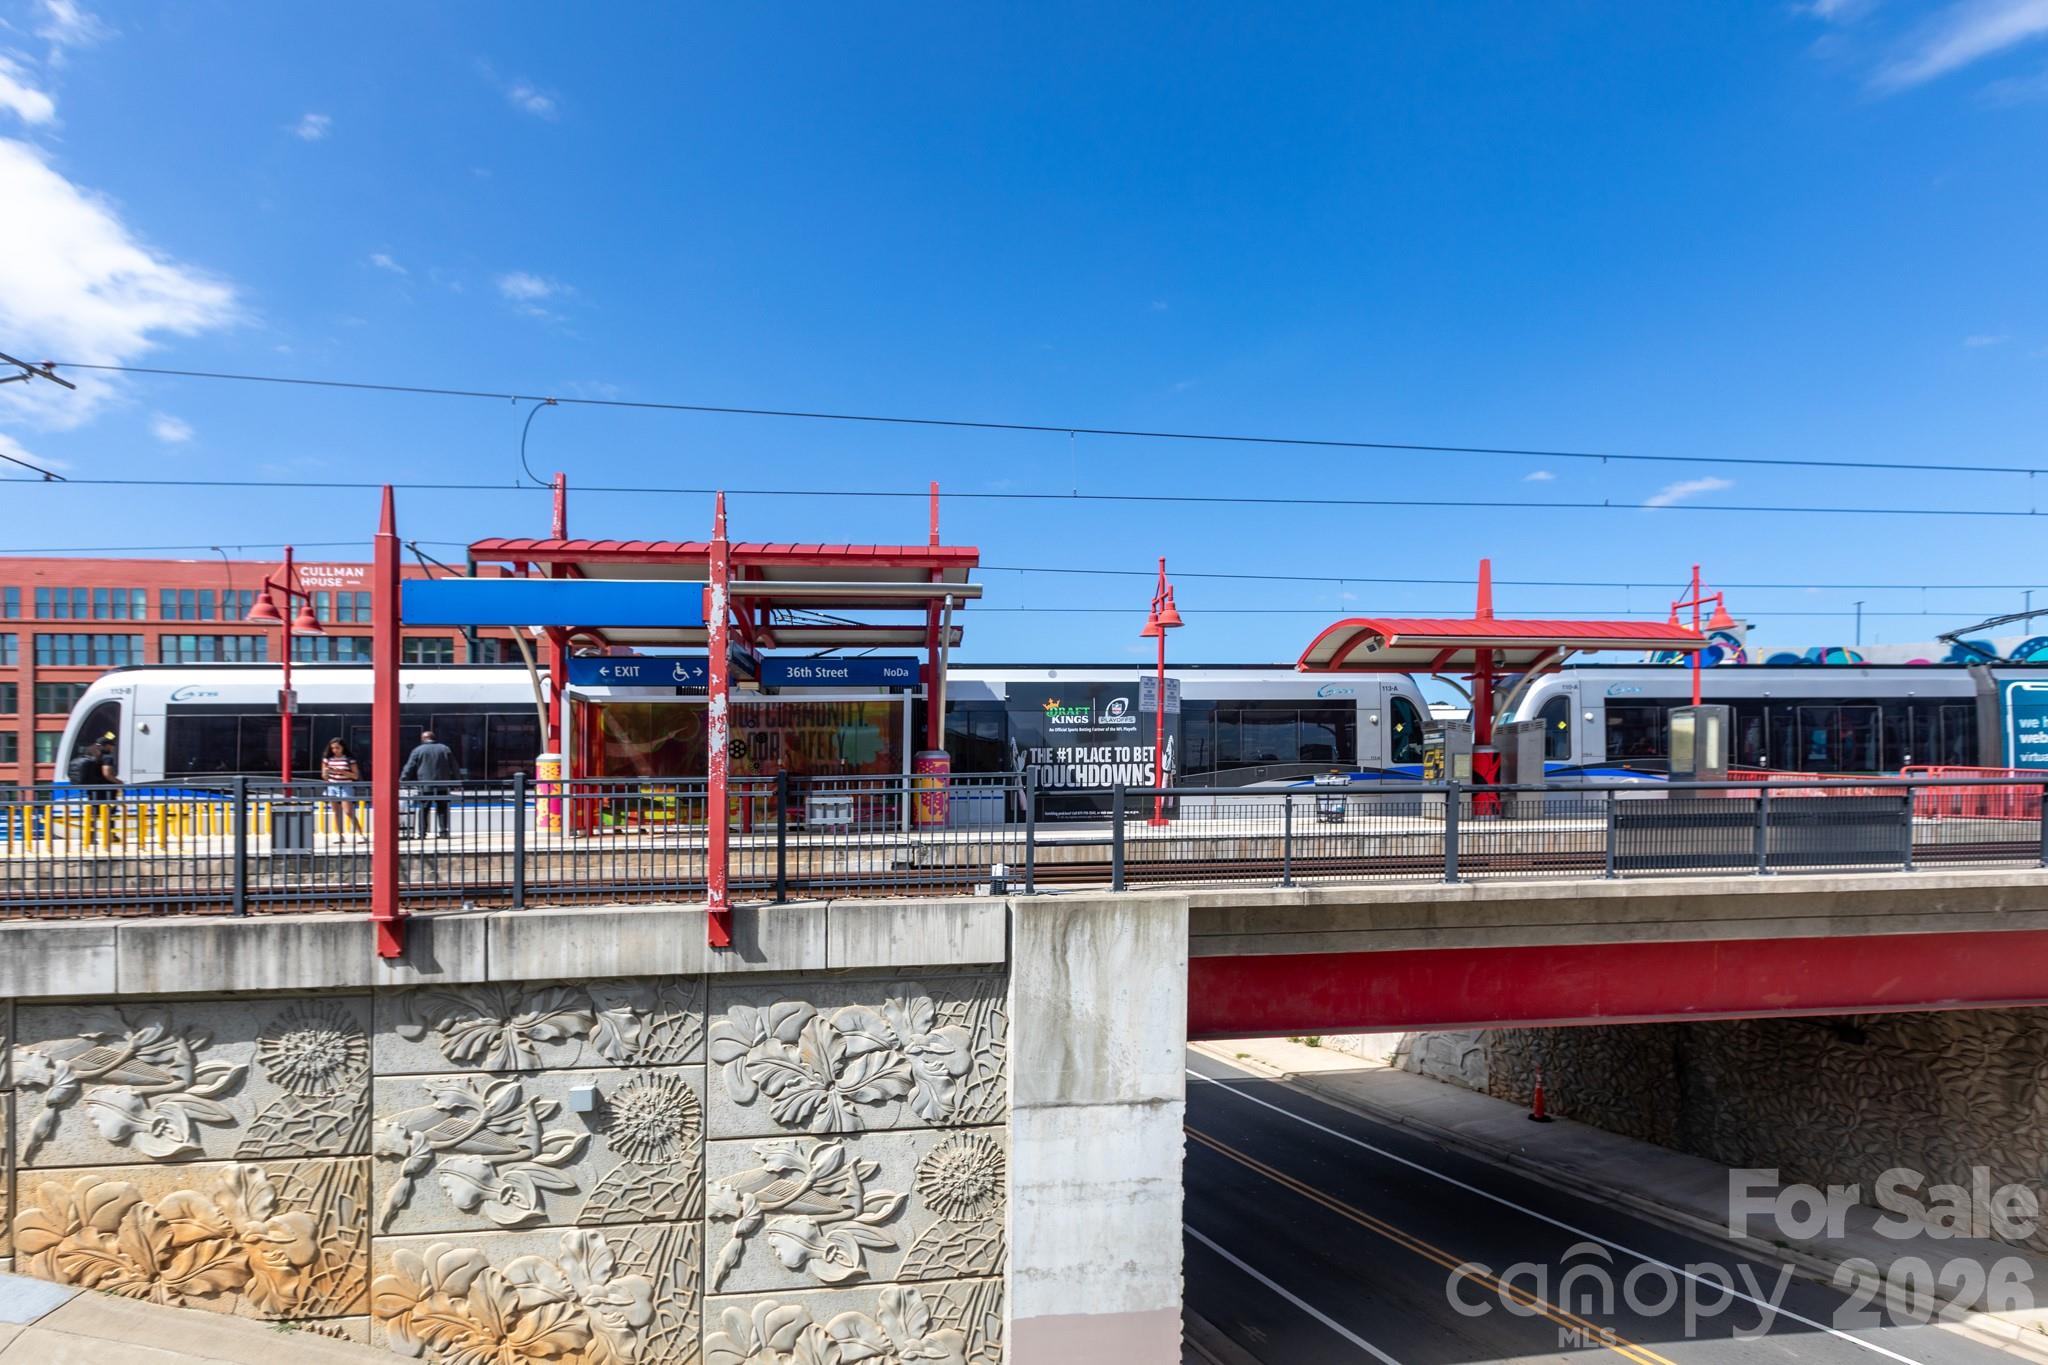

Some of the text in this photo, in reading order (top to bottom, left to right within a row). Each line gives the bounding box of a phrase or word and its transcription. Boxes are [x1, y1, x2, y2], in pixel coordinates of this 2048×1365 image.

[300, 567, 364, 577] CULLMAN
[301, 577, 344, 587] HOUSE
[614, 666, 640, 677] EXIT
[786, 666, 849, 678] 36th Street
[883, 668, 909, 677] NoDa
[1046, 706, 1090, 718] DRAFT
[1052, 715, 1089, 724] KINGS
[2018, 718, 2039, 728] we
[1030, 746, 1156, 763] THE #1 PLACE TO BET
[1027, 763, 1156, 788] TOUCHDOWNS
